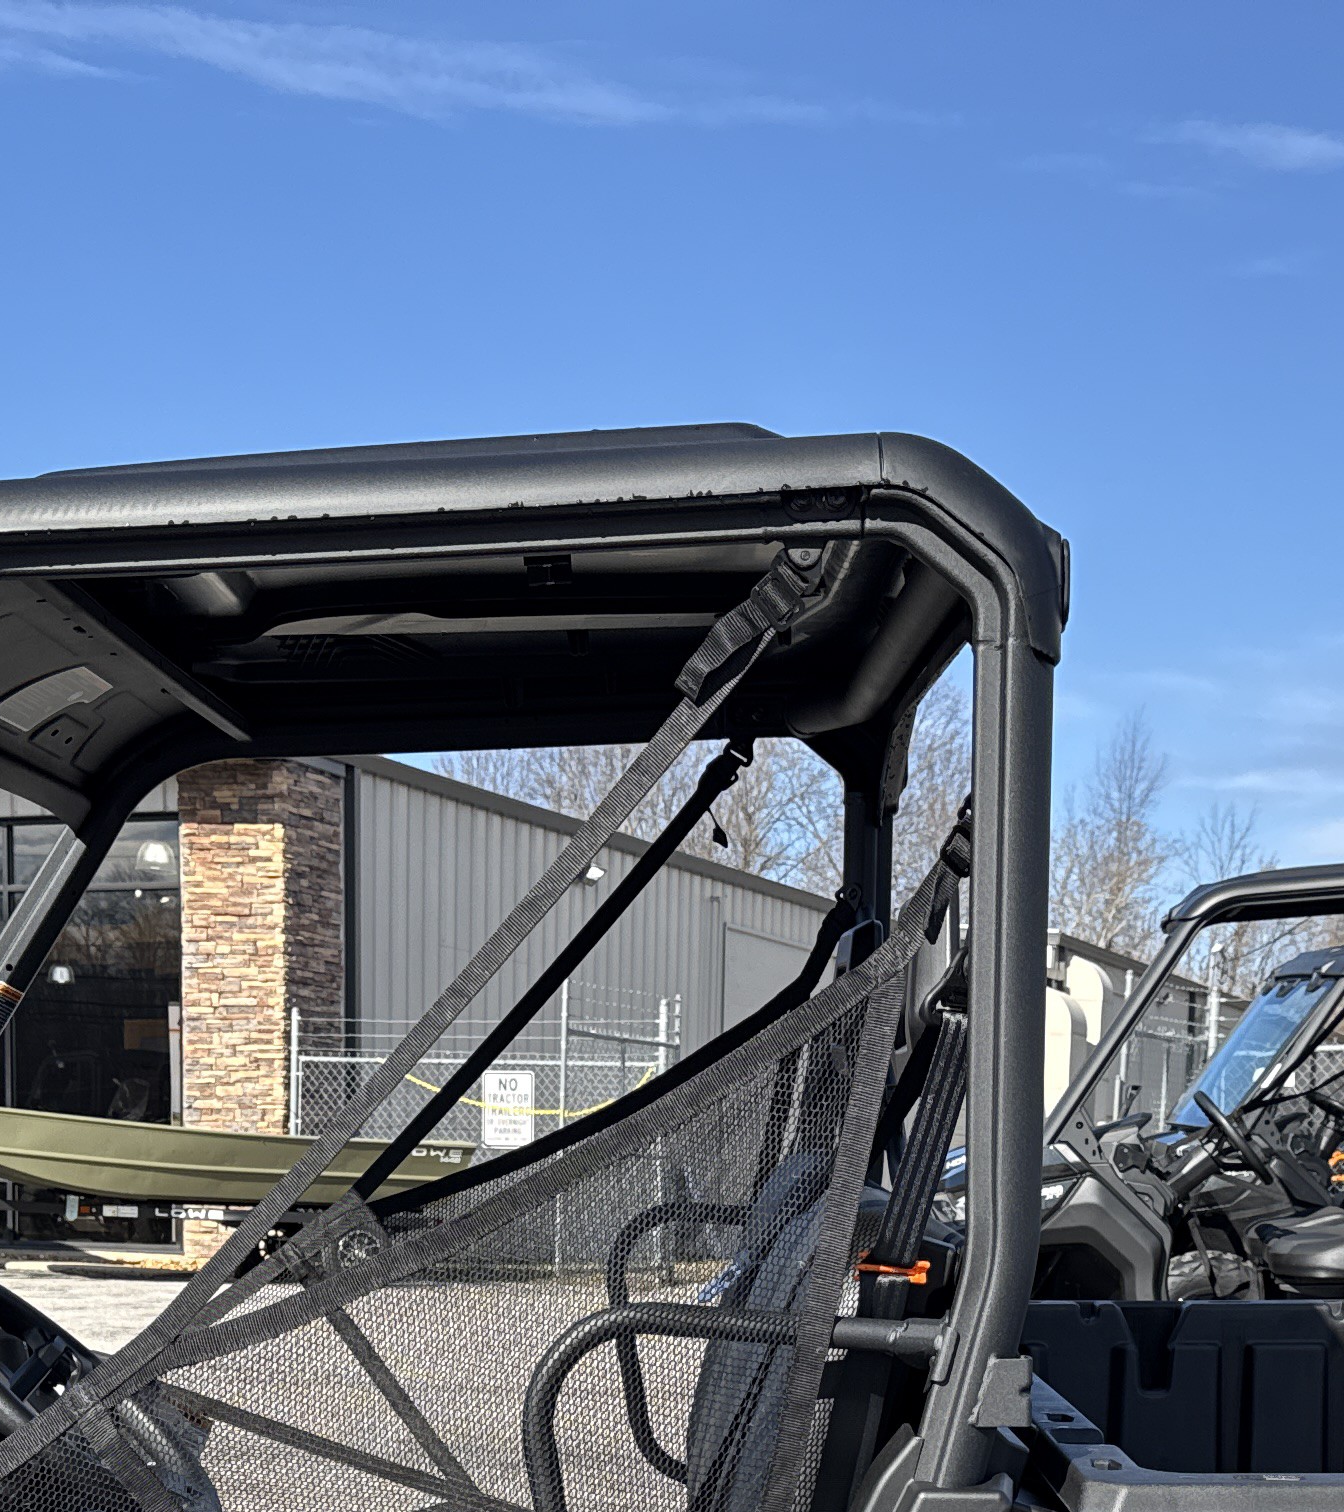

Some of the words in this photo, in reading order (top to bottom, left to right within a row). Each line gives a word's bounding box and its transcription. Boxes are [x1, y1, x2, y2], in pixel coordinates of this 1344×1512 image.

[498, 1078, 518, 1091] NO
[488, 1094, 529, 1104] TRACTOR
[411, 1148, 463, 1158] OWE
